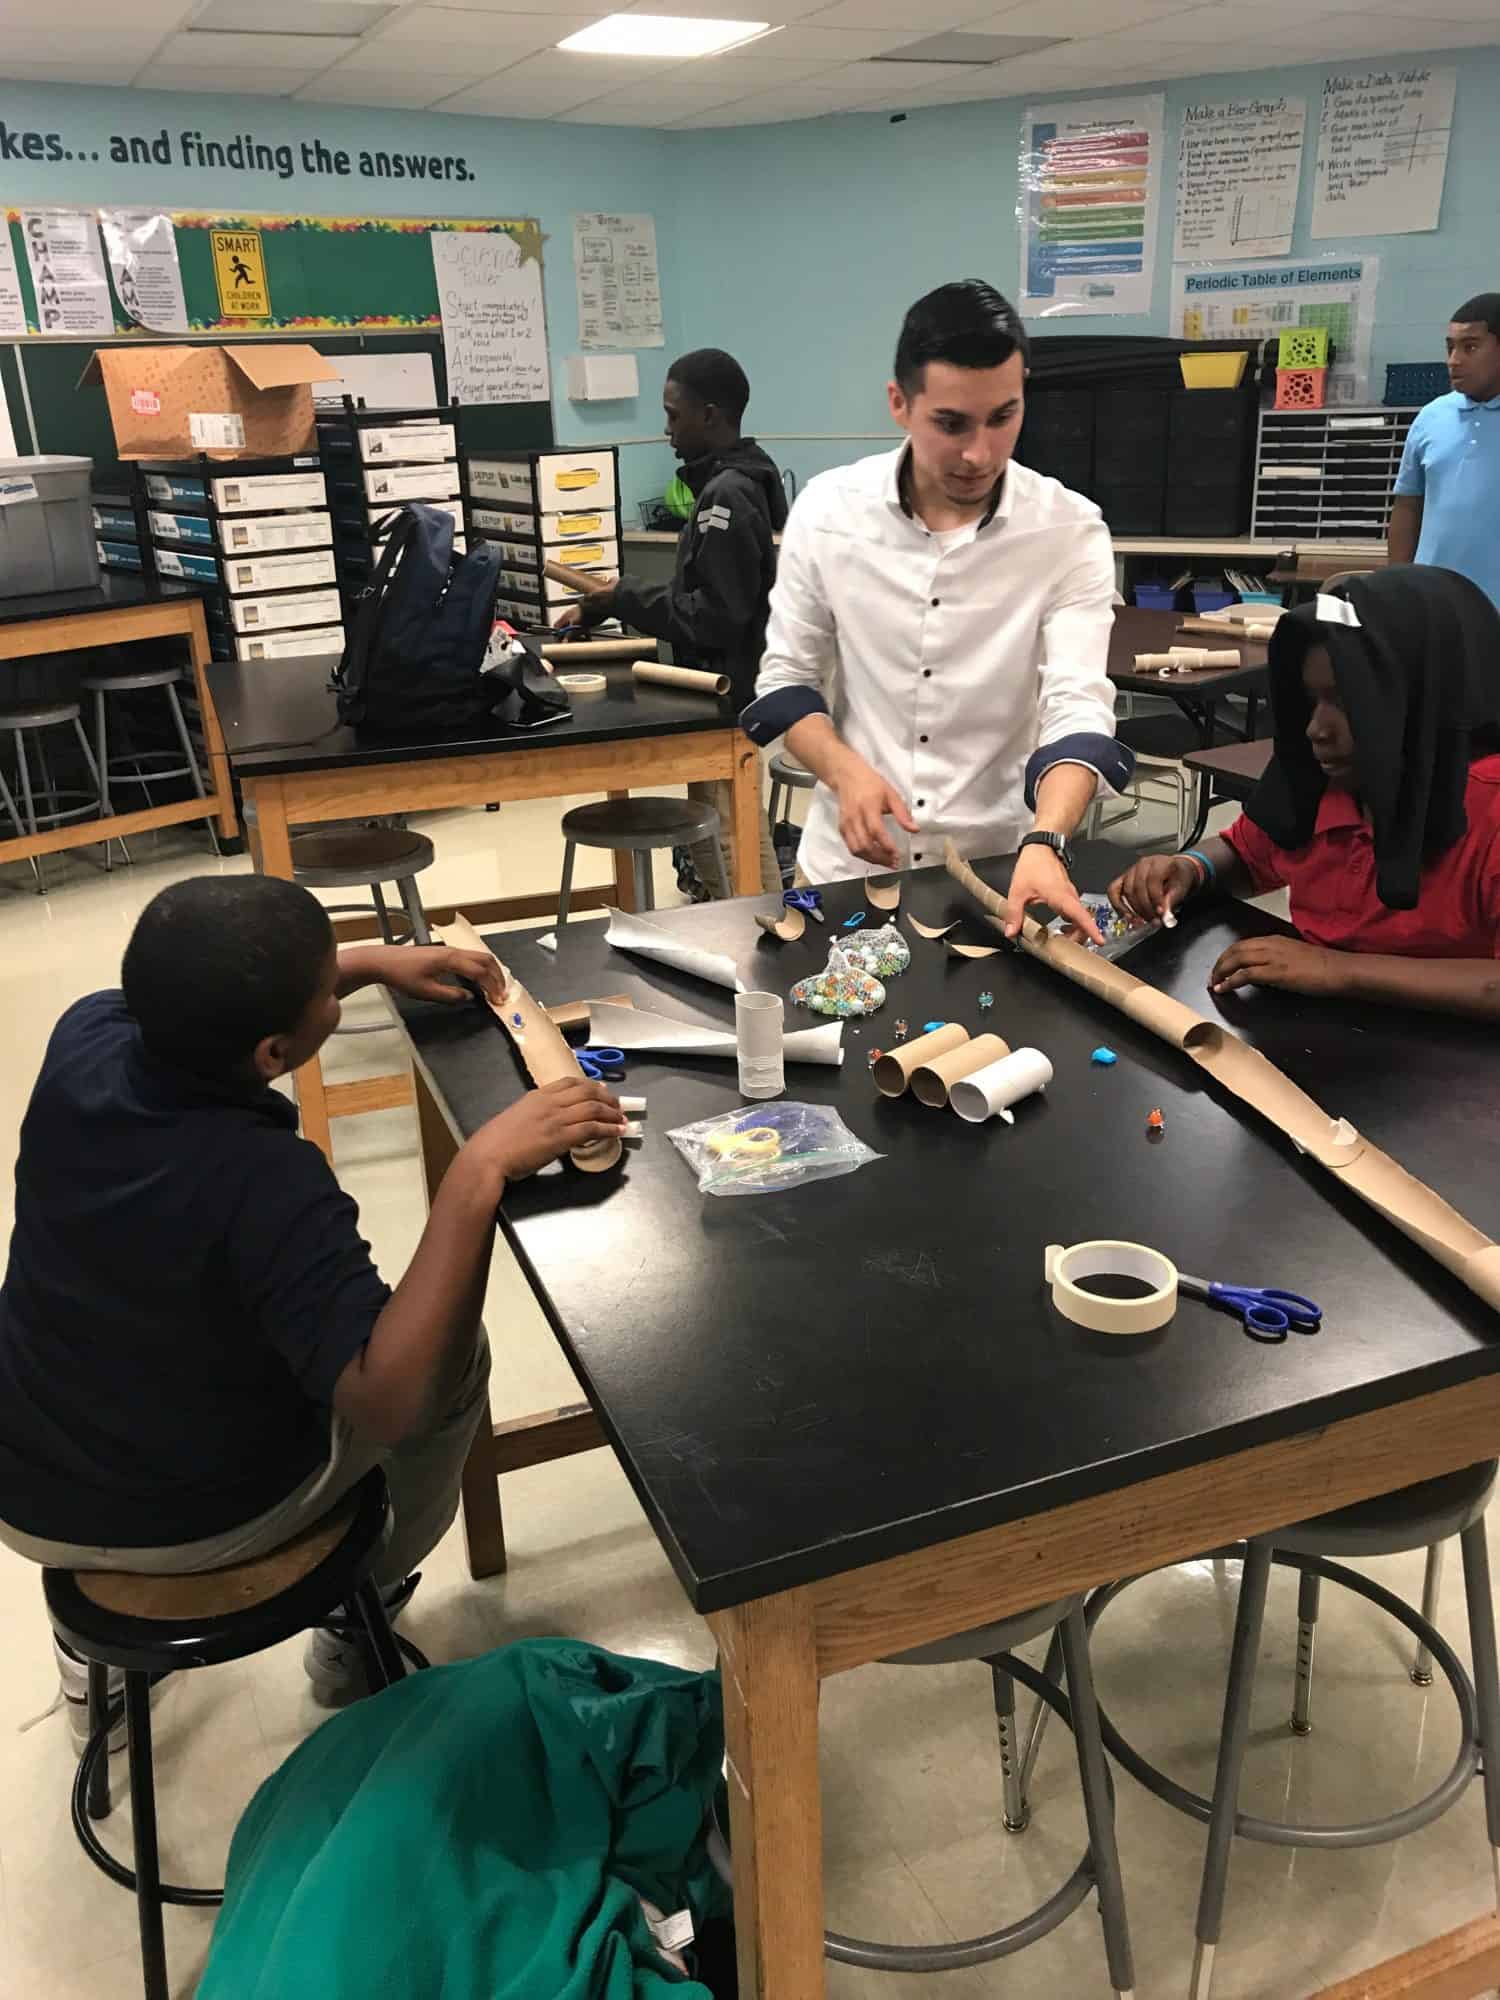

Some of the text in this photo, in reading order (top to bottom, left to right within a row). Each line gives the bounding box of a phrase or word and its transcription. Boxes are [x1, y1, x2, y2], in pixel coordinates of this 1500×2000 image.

[109, 129, 171, 165] and
[181, 131, 294, 179] finding
[301, 139, 351, 176] the
[359, 151, 475, 182] answers.
[216, 236, 257, 253] SMART
[1186, 266, 1361, 291] Periodic Table of Elements
